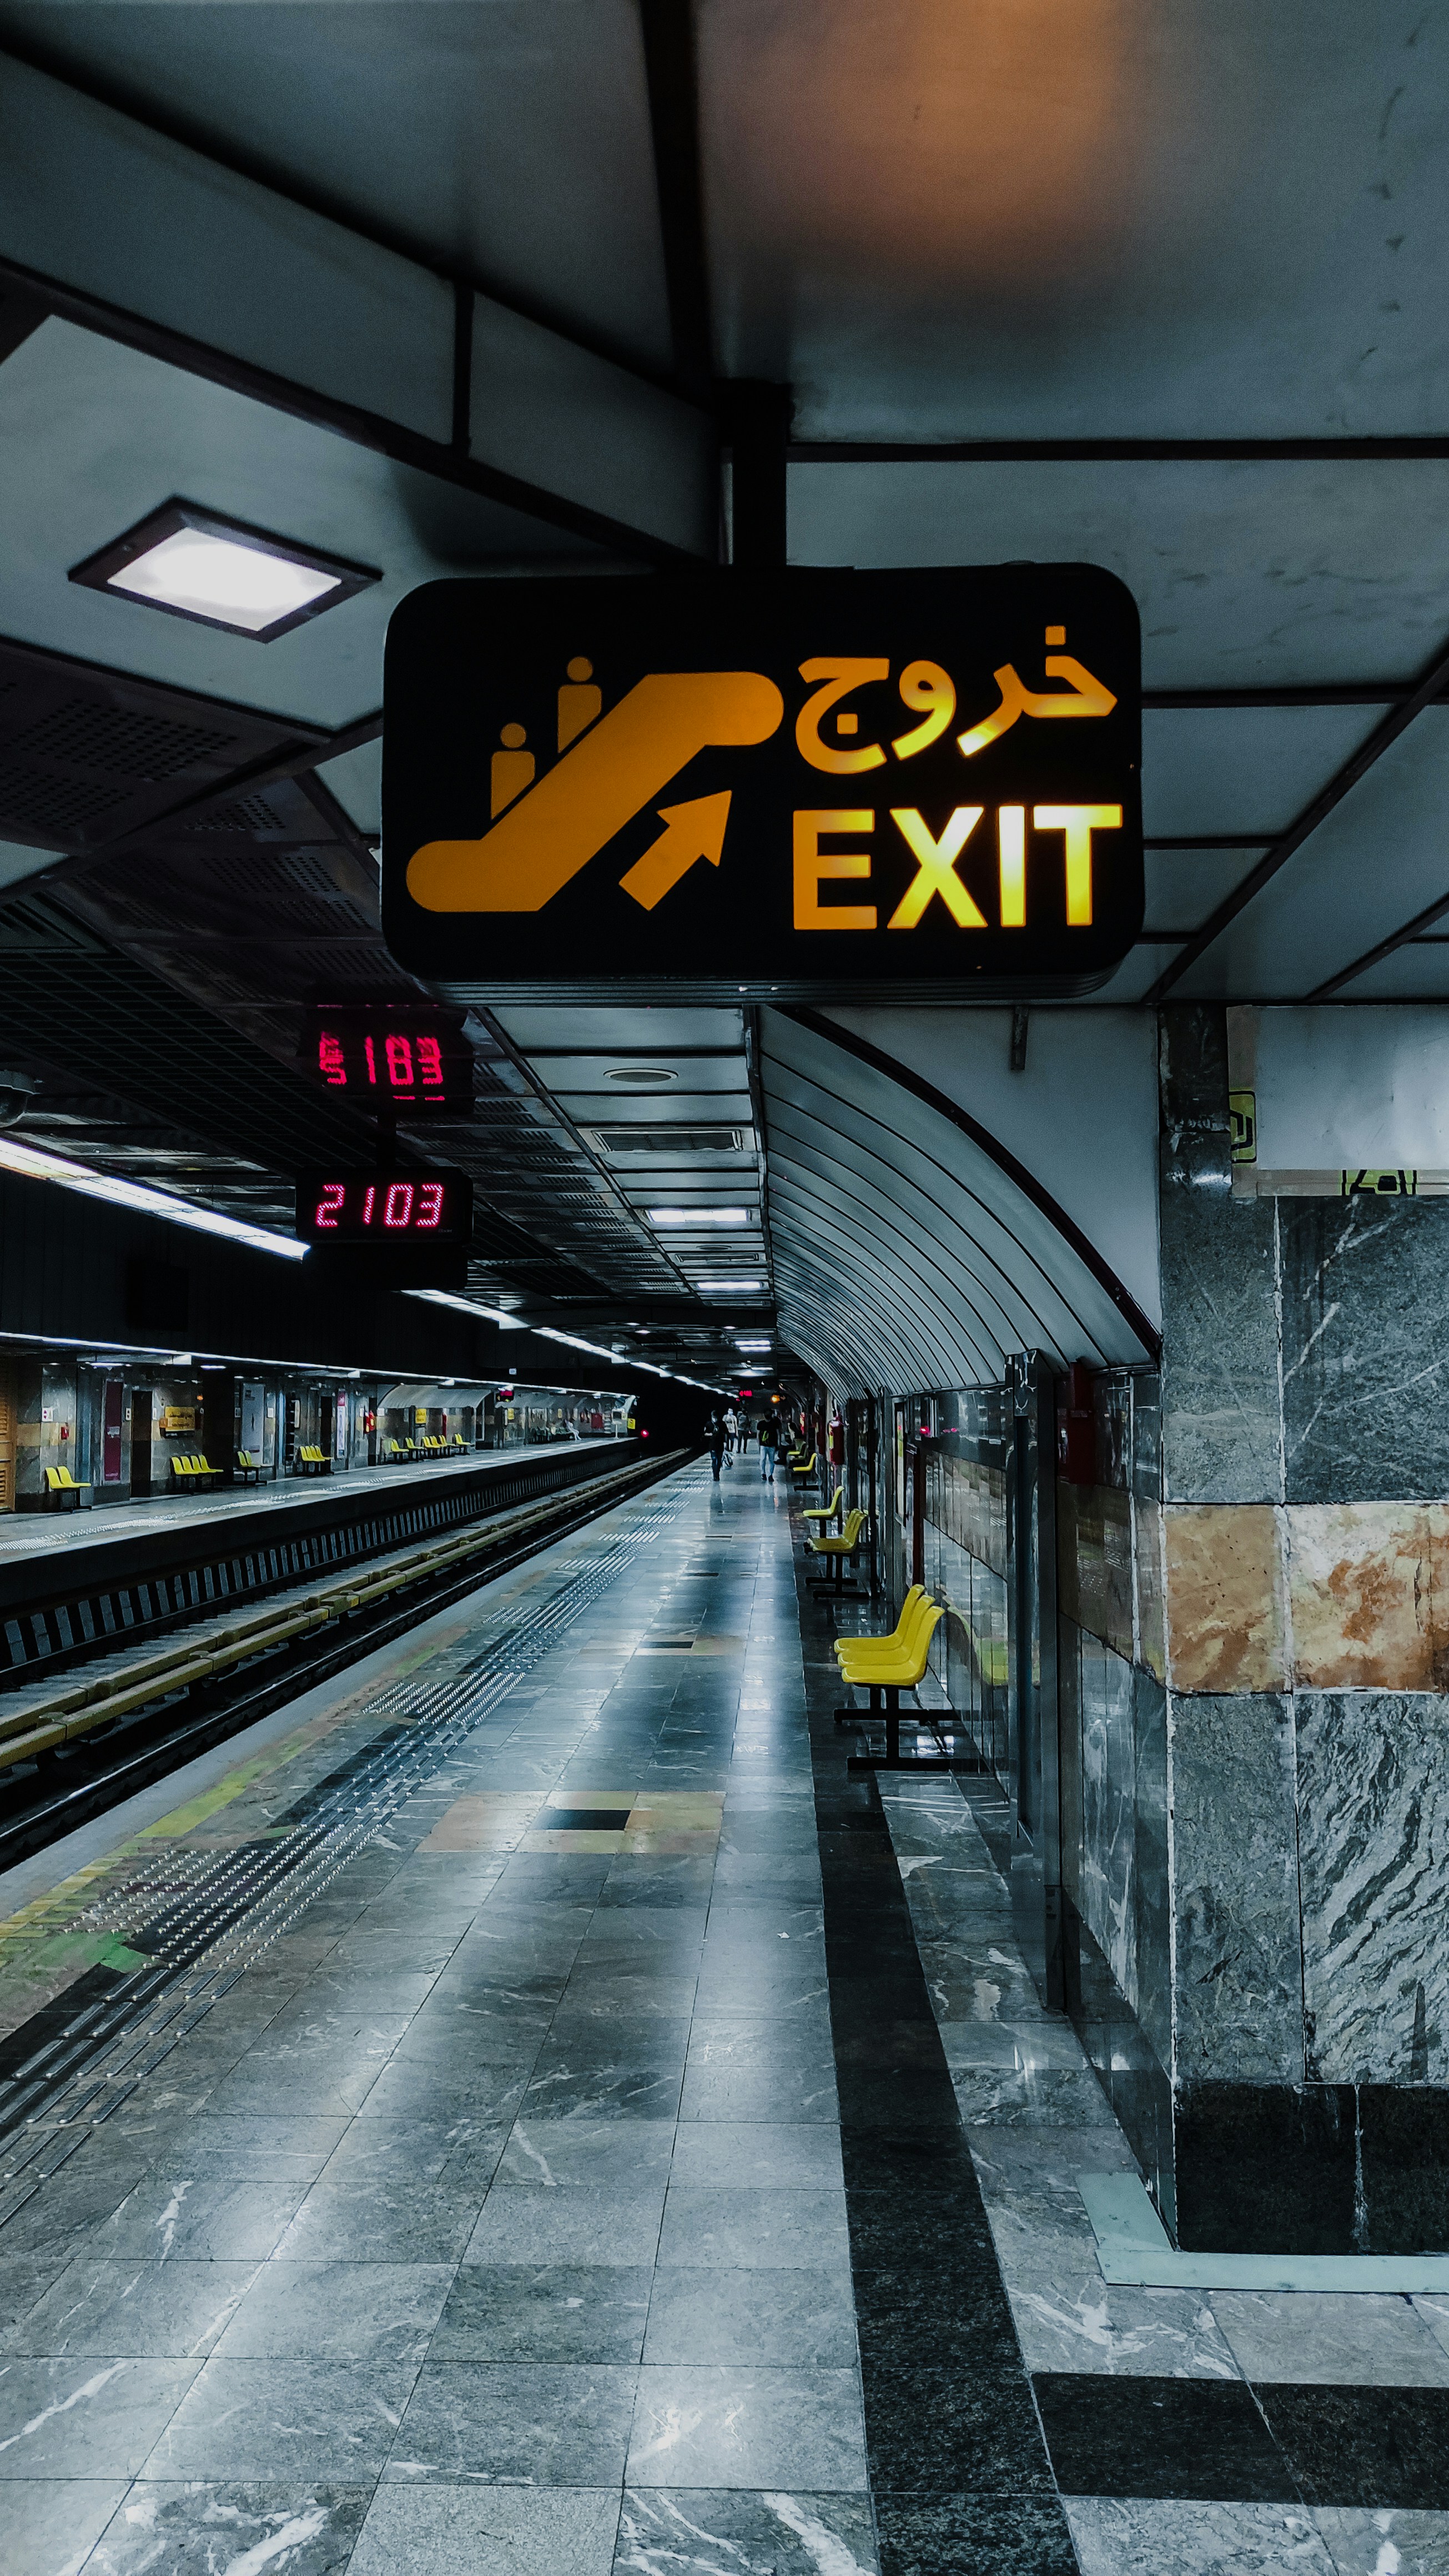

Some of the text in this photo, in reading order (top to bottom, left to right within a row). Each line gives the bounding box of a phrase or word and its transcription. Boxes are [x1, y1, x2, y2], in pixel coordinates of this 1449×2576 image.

[795, 625, 1118, 774] خروج
[793, 803, 1123, 930] EXIT
[315, 1184, 445, 1227] 2103
